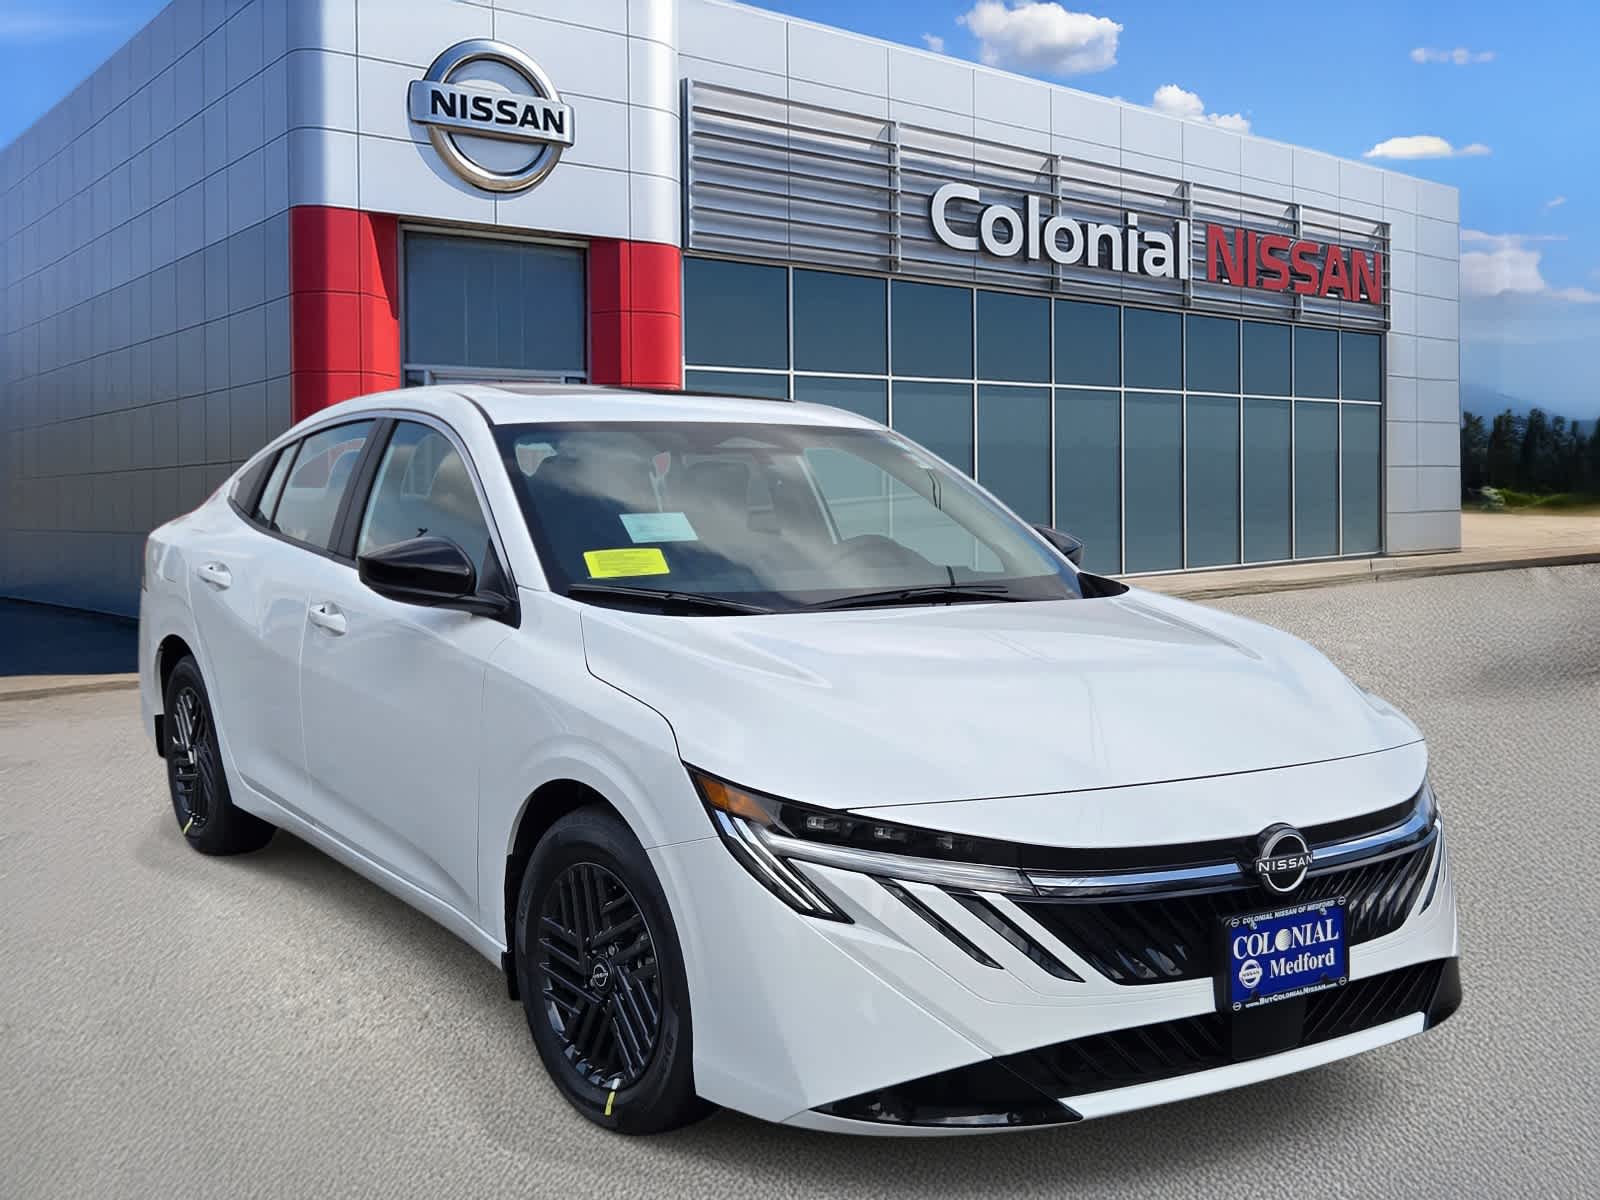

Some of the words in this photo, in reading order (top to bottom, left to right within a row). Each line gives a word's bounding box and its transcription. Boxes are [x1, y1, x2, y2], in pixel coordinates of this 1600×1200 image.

[431, 89, 564, 134] NISSAN
[930, 182, 1188, 279] Colonial
[1206, 222, 1383, 304] NISSAN
[1258, 854, 1313, 872] NISSAN
[1243, 912, 1273, 924] COLONIAL
[1274, 907, 1297, 919] NISSAN
[1298, 905, 1306, 914] OF
[1233, 918, 1339, 960] COLONIAL
[1270, 948, 1335, 978] Medford
